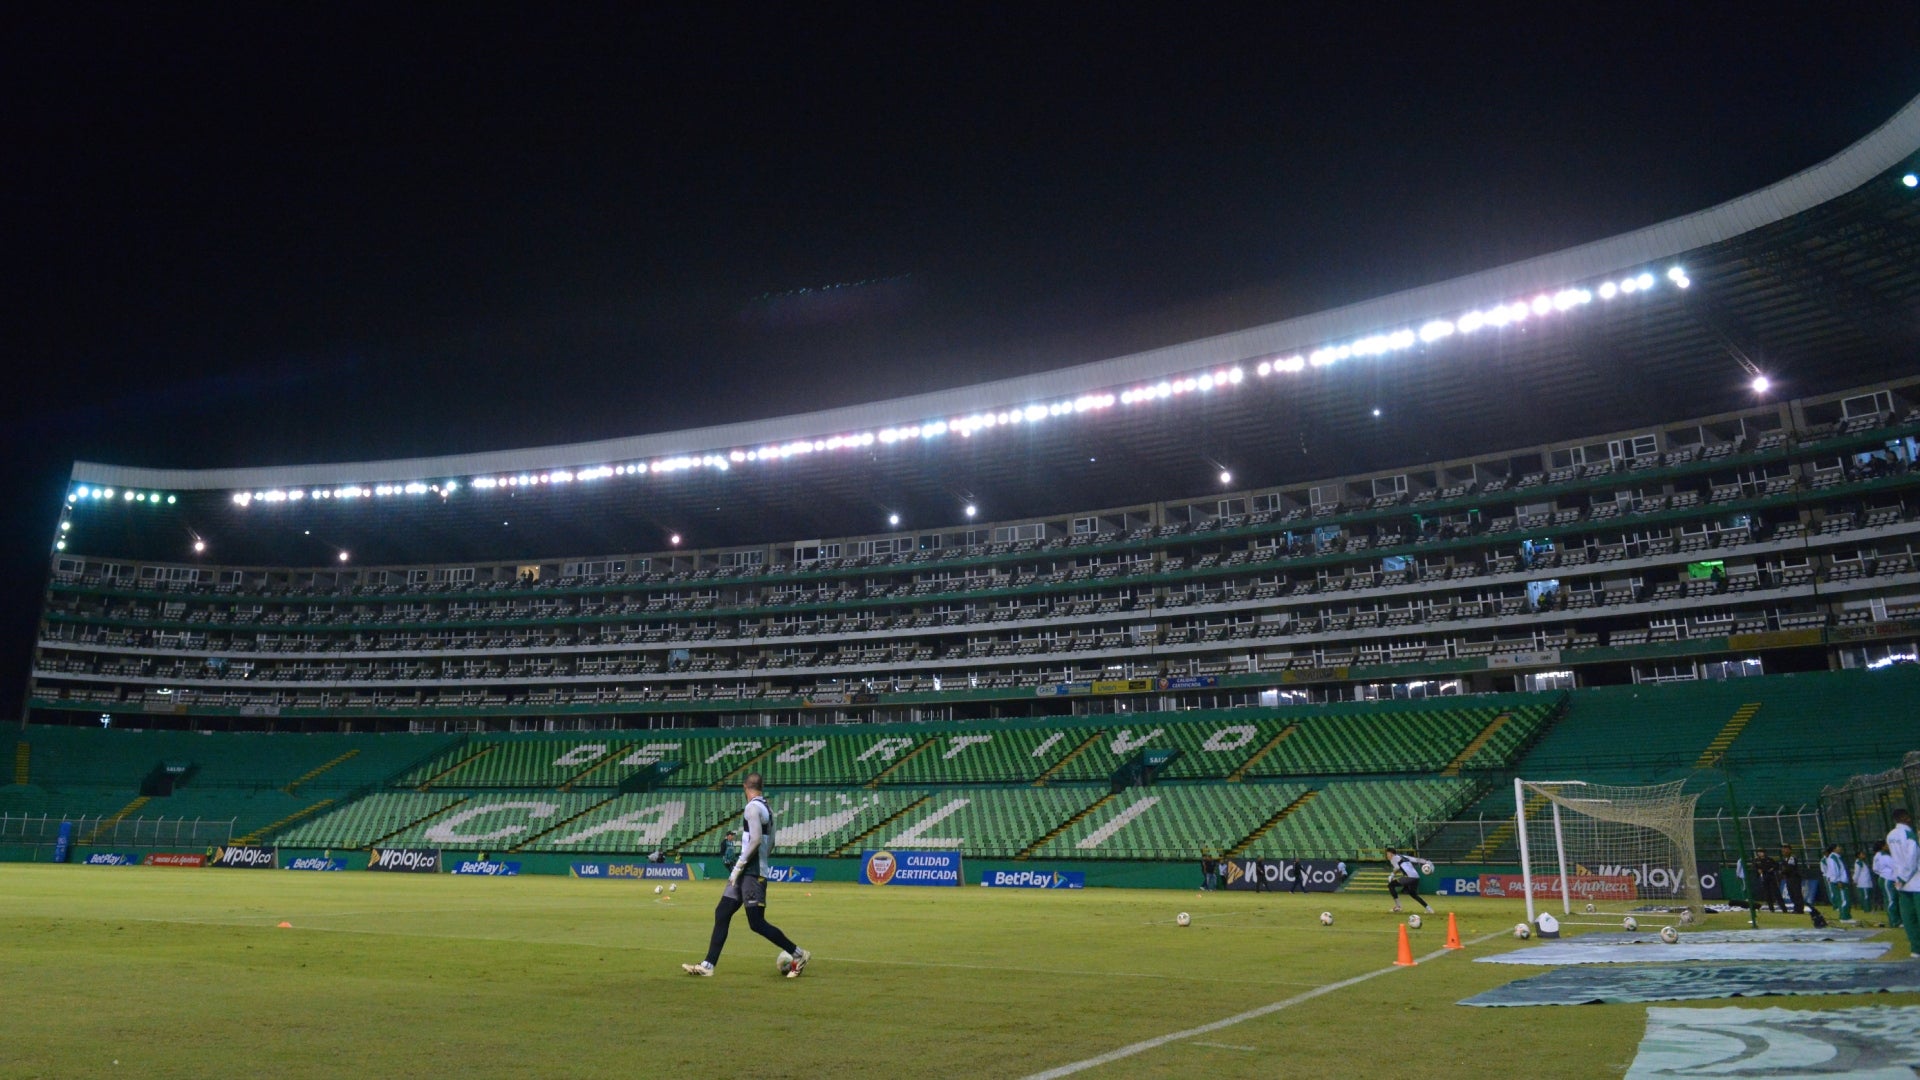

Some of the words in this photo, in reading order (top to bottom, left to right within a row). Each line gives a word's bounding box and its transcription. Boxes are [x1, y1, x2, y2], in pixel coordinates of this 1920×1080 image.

[552, 725, 1257, 766] DEPORTIVO
[89, 853, 120, 866] BetPlay
[292, 858, 327, 870] BetPlay
[379, 848, 435, 869] Wplay.co
[907, 856, 950, 867] CALIDAD
[460, 861, 499, 875] BetPlay
[581, 864, 599, 875] LIGA
[608, 864, 645, 879] BetPlay
[646, 866, 684, 877] DIMAYOR
[895, 869, 958, 880] CERTIFICADA
[994, 871, 1052, 889] BetPlay
